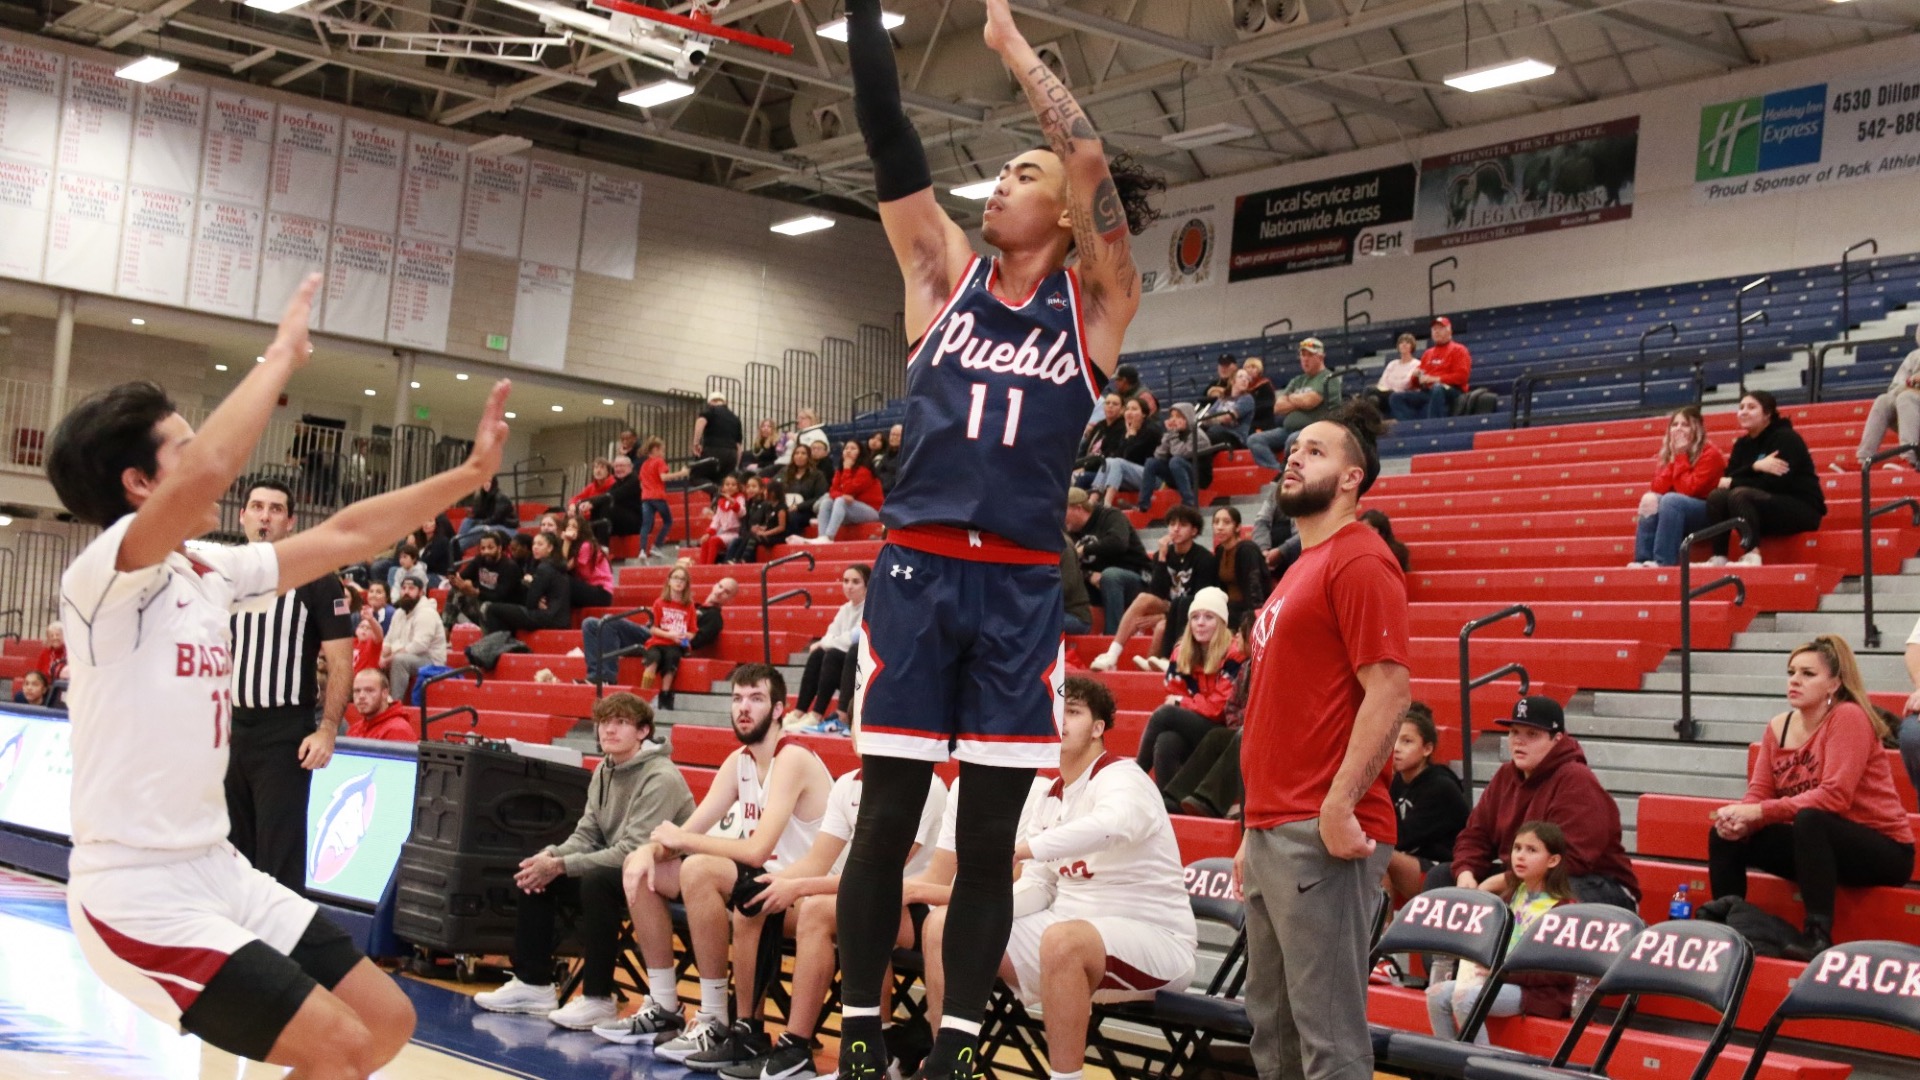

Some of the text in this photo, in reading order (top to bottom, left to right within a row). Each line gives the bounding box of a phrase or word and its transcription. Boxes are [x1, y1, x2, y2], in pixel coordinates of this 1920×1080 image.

[72, 70, 129, 90] BASKETBALL
[81, 80, 120, 93] NATIONAL
[72, 86, 128, 103] TOURNAMENT
[72, 93, 127, 111] APPEARANCES
[145, 85, 199, 105] VOLLEYBALL
[153, 96, 190, 110] NATIONAL
[1833, 82, 1920, 113] 4530 Dillon
[144, 108, 197, 126] APPEARANCES
[145, 101, 198, 118] TOURNAMENT
[216, 100, 270, 121] WRESTLING
[222, 111, 259, 125] NATIONAL
[1765, 100, 1823, 121] Holiday Inn
[283, 114, 335, 135] FOOTBALL
[1763, 120, 1820, 144] Express
[290, 127, 326, 140] NATIONAL
[351, 130, 396, 148] SOFTBALL
[282, 138, 332, 155] APPEARANCES
[349, 146, 398, 161] TOURNAMENT
[415, 144, 460, 162] BASEBALL
[348, 153, 397, 168] APPEARANCES
[474, 156, 524, 175] MEN'S GOLF
[76, 176, 104, 189] MEN'S
[1752, 173, 1812, 194] Sponsor
[1816, 167, 1833, 182] of
[1838, 161, 1871, 179] Pack
[60, 182, 85, 195] TRACK
[97, 190, 119, 202] FIELD
[68, 193, 107, 206] NATIONAL
[142, 190, 182, 205] WOMEN'S
[1265, 177, 1380, 217] Local Service and
[140, 208, 178, 221] NATIONAL
[144, 200, 179, 213] TENNIS
[217, 204, 247, 217] MEN'S
[1469, 189, 1604, 229] LEGACY BANK
[132, 213, 185, 229] TOURNAMENT
[132, 220, 185, 236] APPEARANCES
[210, 221, 248, 234] NATIONAL
[216, 213, 247, 226] TENNIS
[281, 215, 318, 230] WOMEN'S
[1259, 203, 1382, 240] Nationwide Access
[203, 226, 255, 241] TOURNAMENT
[277, 233, 316, 246] NATIONAL
[282, 225, 314, 238] SOCCER
[345, 227, 383, 242] WOMEN'S
[202, 234, 253, 249] APPEARANCES
[269, 237, 323, 255] TOURNAMENT
[333, 235, 393, 254] CROSS COUNTRY
[415, 242, 440, 254] MEN'S
[1376, 230, 1403, 251] Ent
[268, 246, 322, 263] APPEARANCES
[335, 251, 388, 267] TOURNAMENT
[343, 246, 381, 258] NATIONAL
[398, 248, 453, 266] CROSS COUNTRY
[334, 259, 386, 276] APPEARANCES
[399, 263, 450, 278] TOURNAMENT
[407, 257, 444, 271] NATIONAL
[398, 271, 449, 286] APPEARANCES
[931, 311, 1079, 386] Pueblo
[966, 382, 1024, 447] 11
[175, 642, 231, 678] BAC
[1404, 896, 1495, 935] PACK
[1533, 913, 1630, 954] PACK
[1630, 929, 1731, 974] PACK
[1814, 950, 1920, 997] PACK
